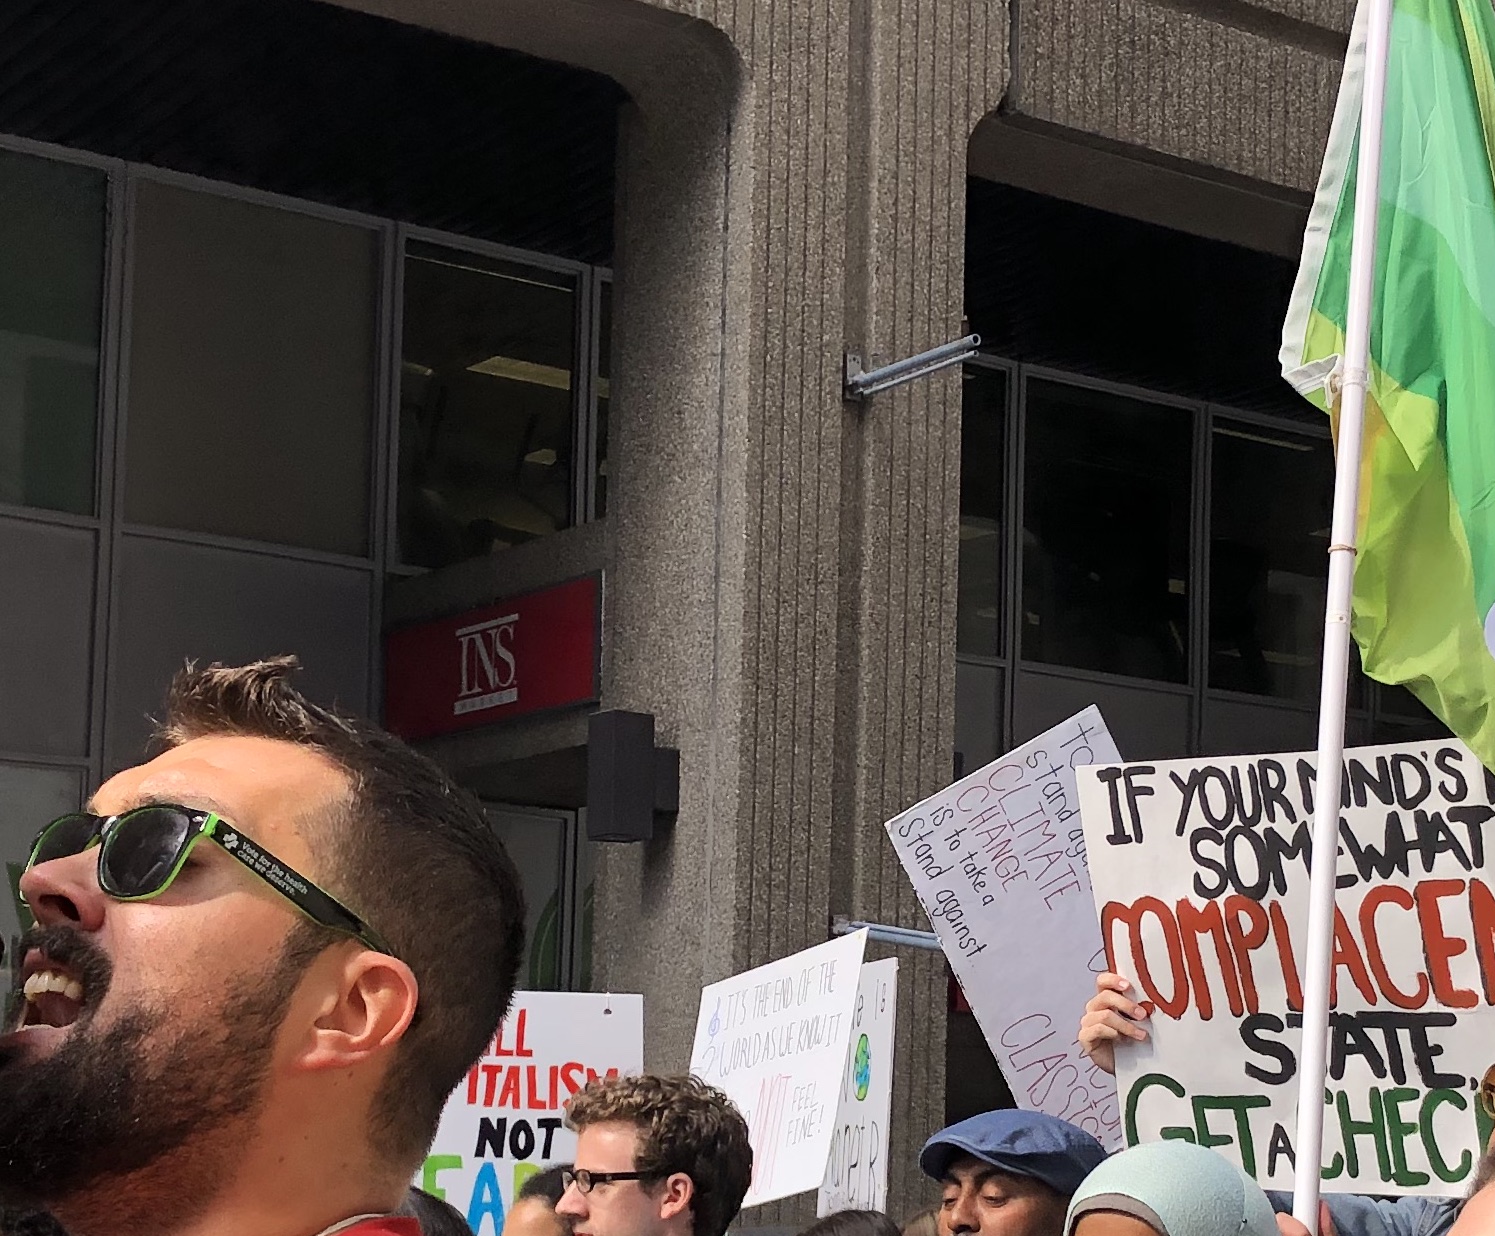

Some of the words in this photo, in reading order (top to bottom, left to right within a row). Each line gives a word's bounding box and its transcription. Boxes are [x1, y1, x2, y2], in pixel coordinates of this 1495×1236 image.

[458, 622, 517, 697] INS
[1025, 750, 1081, 824] stand
[1096, 765, 1156, 846] IF
[1169, 758, 1298, 837] YOUR
[944, 827, 967, 851] to
[959, 851, 988, 894] take
[983, 894, 995, 907] a
[956, 785, 1029, 893] CHANGE
[988, 764, 1081, 911] CLIMATE
[242, 842, 259, 859] Vote
[259, 855, 272, 868] for
[271, 863, 285, 878] the
[284, 872, 308, 895] health
[254, 862, 267, 873] we
[265, 870, 297, 896] deserve.
[753, 982, 773, 1020] THE
[773, 976, 793, 1014] END
[797, 966, 815, 1006] OF
[818, 959, 838, 995] THE
[484, 1008, 534, 1057] LL
[719, 1031, 761, 1078] WORLD
[761, 1027, 777, 1062] AS
[778, 1021, 794, 1058] WE
[795, 1017, 826, 1055] KNOW
[474, 1116, 563, 1161] NOT
[1267, 1122, 1298, 1178] A
